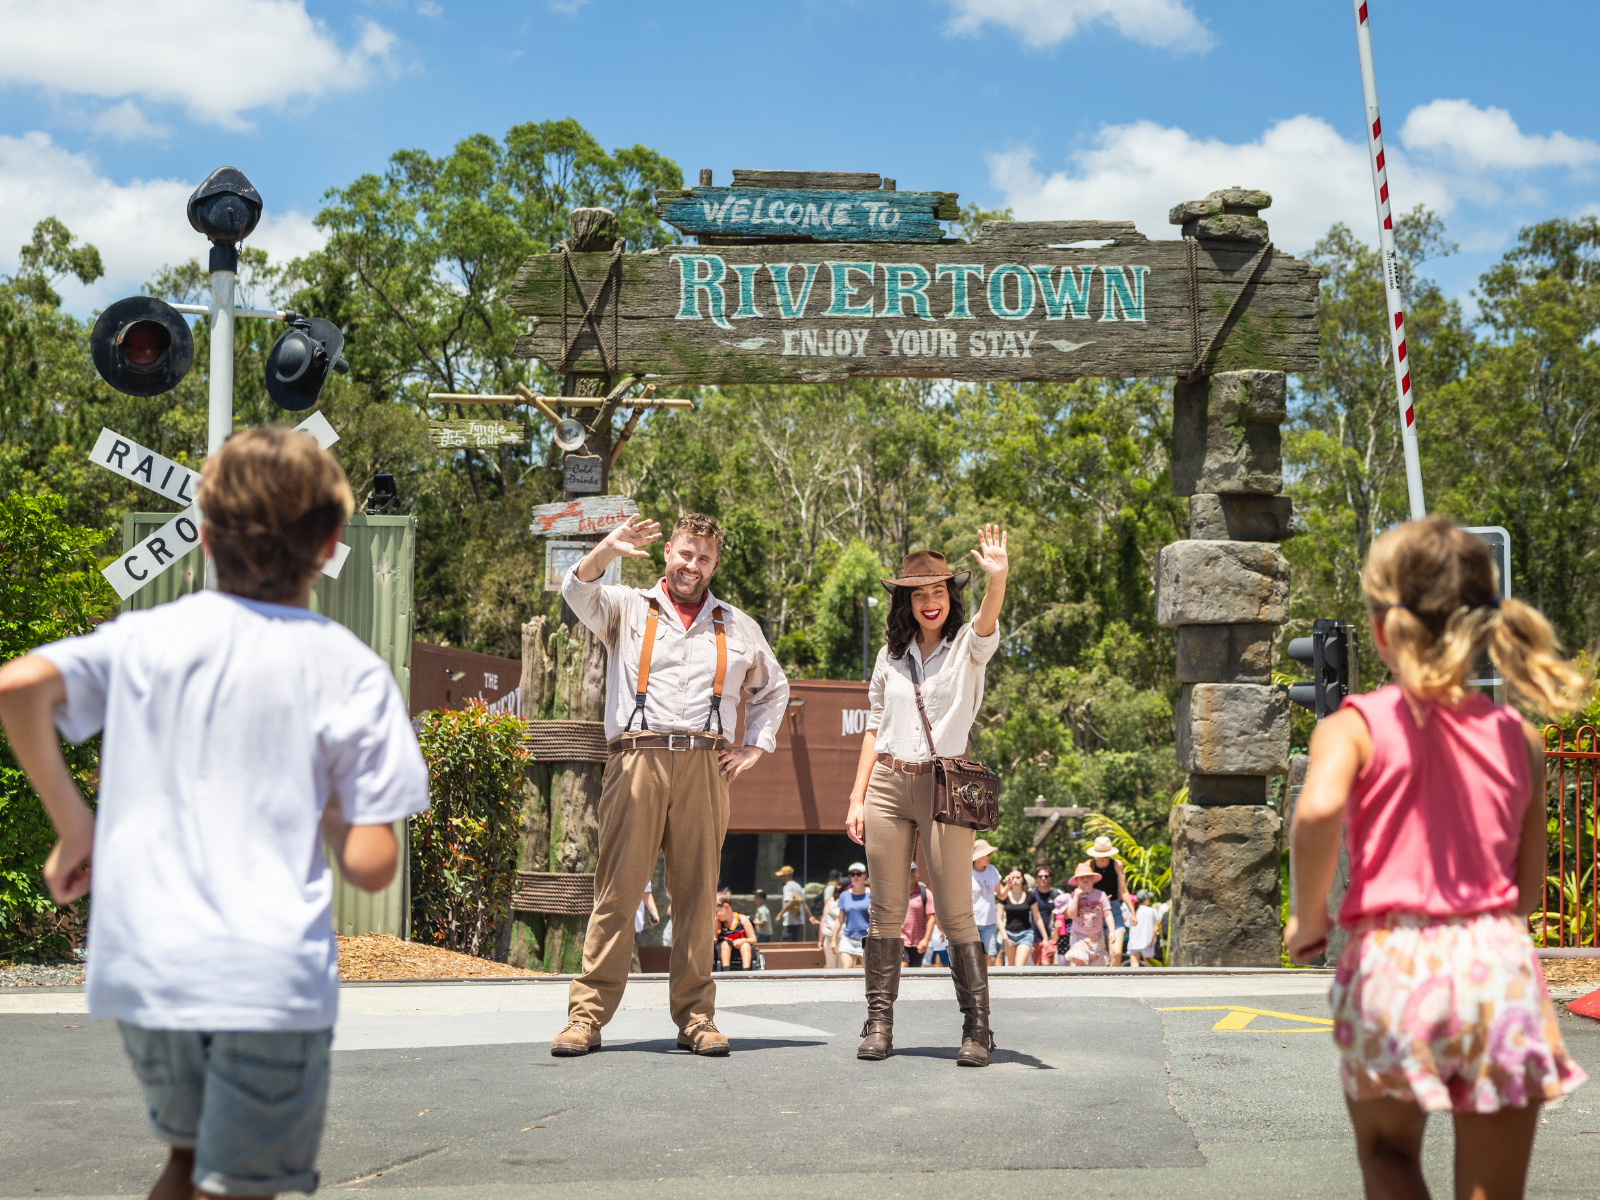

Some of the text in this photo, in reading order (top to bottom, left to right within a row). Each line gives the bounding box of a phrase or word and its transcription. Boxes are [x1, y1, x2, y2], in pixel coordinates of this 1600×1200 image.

[699, 195, 902, 232] WELCOME TO
[669, 253, 1152, 330] RIVERTOWN
[781, 328, 1040, 360] ENJOY YOUR STAY
[473, 433, 501, 448] Tour
[568, 473, 599, 485] Drinks
[572, 463, 593, 474] Cold
[578, 506, 627, 533] Ahead
[483, 672, 498, 690] THE
